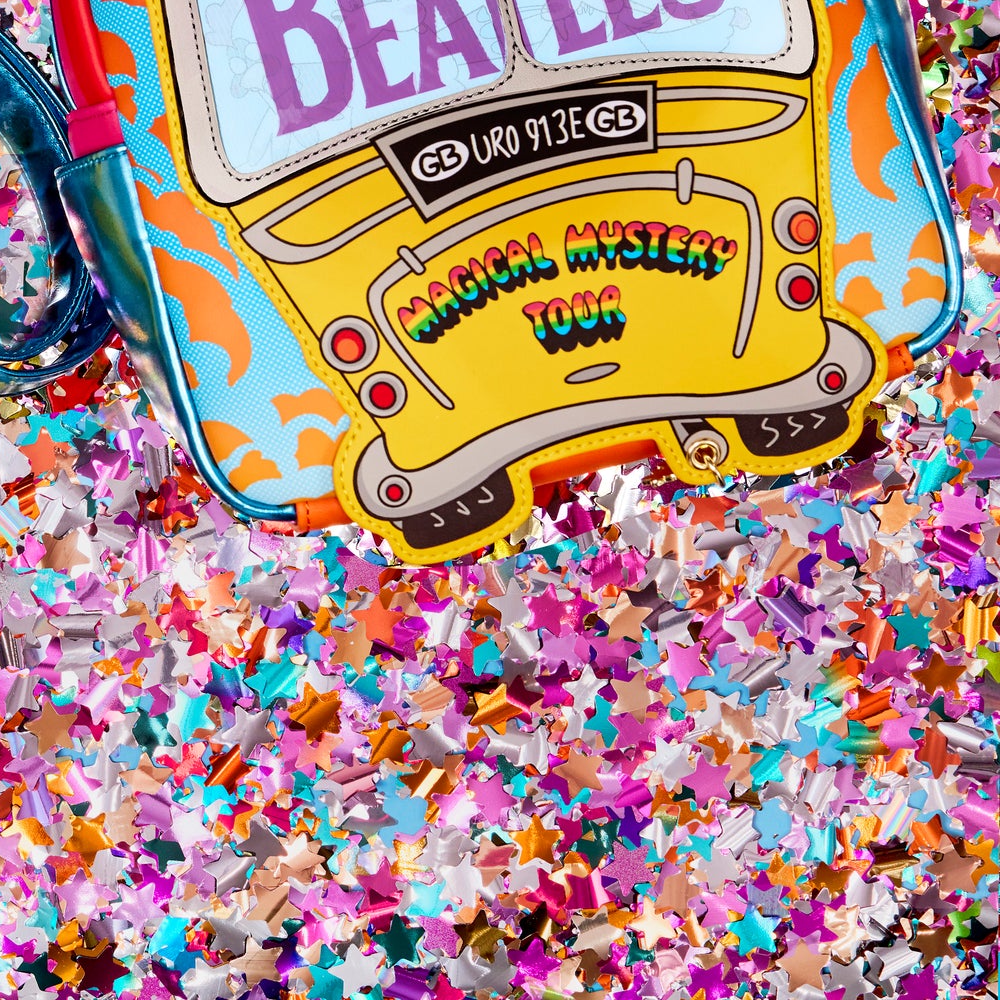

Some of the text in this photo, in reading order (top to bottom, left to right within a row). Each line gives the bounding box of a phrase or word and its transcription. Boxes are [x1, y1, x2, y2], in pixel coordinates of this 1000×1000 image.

[417, 144, 466, 177] GB
[525, 106, 586, 152] 913E
[593, 103, 639, 132] GB
[397, 220, 738, 344] MAGICAL MYSTERY
[522, 285, 627, 355] TOUR
